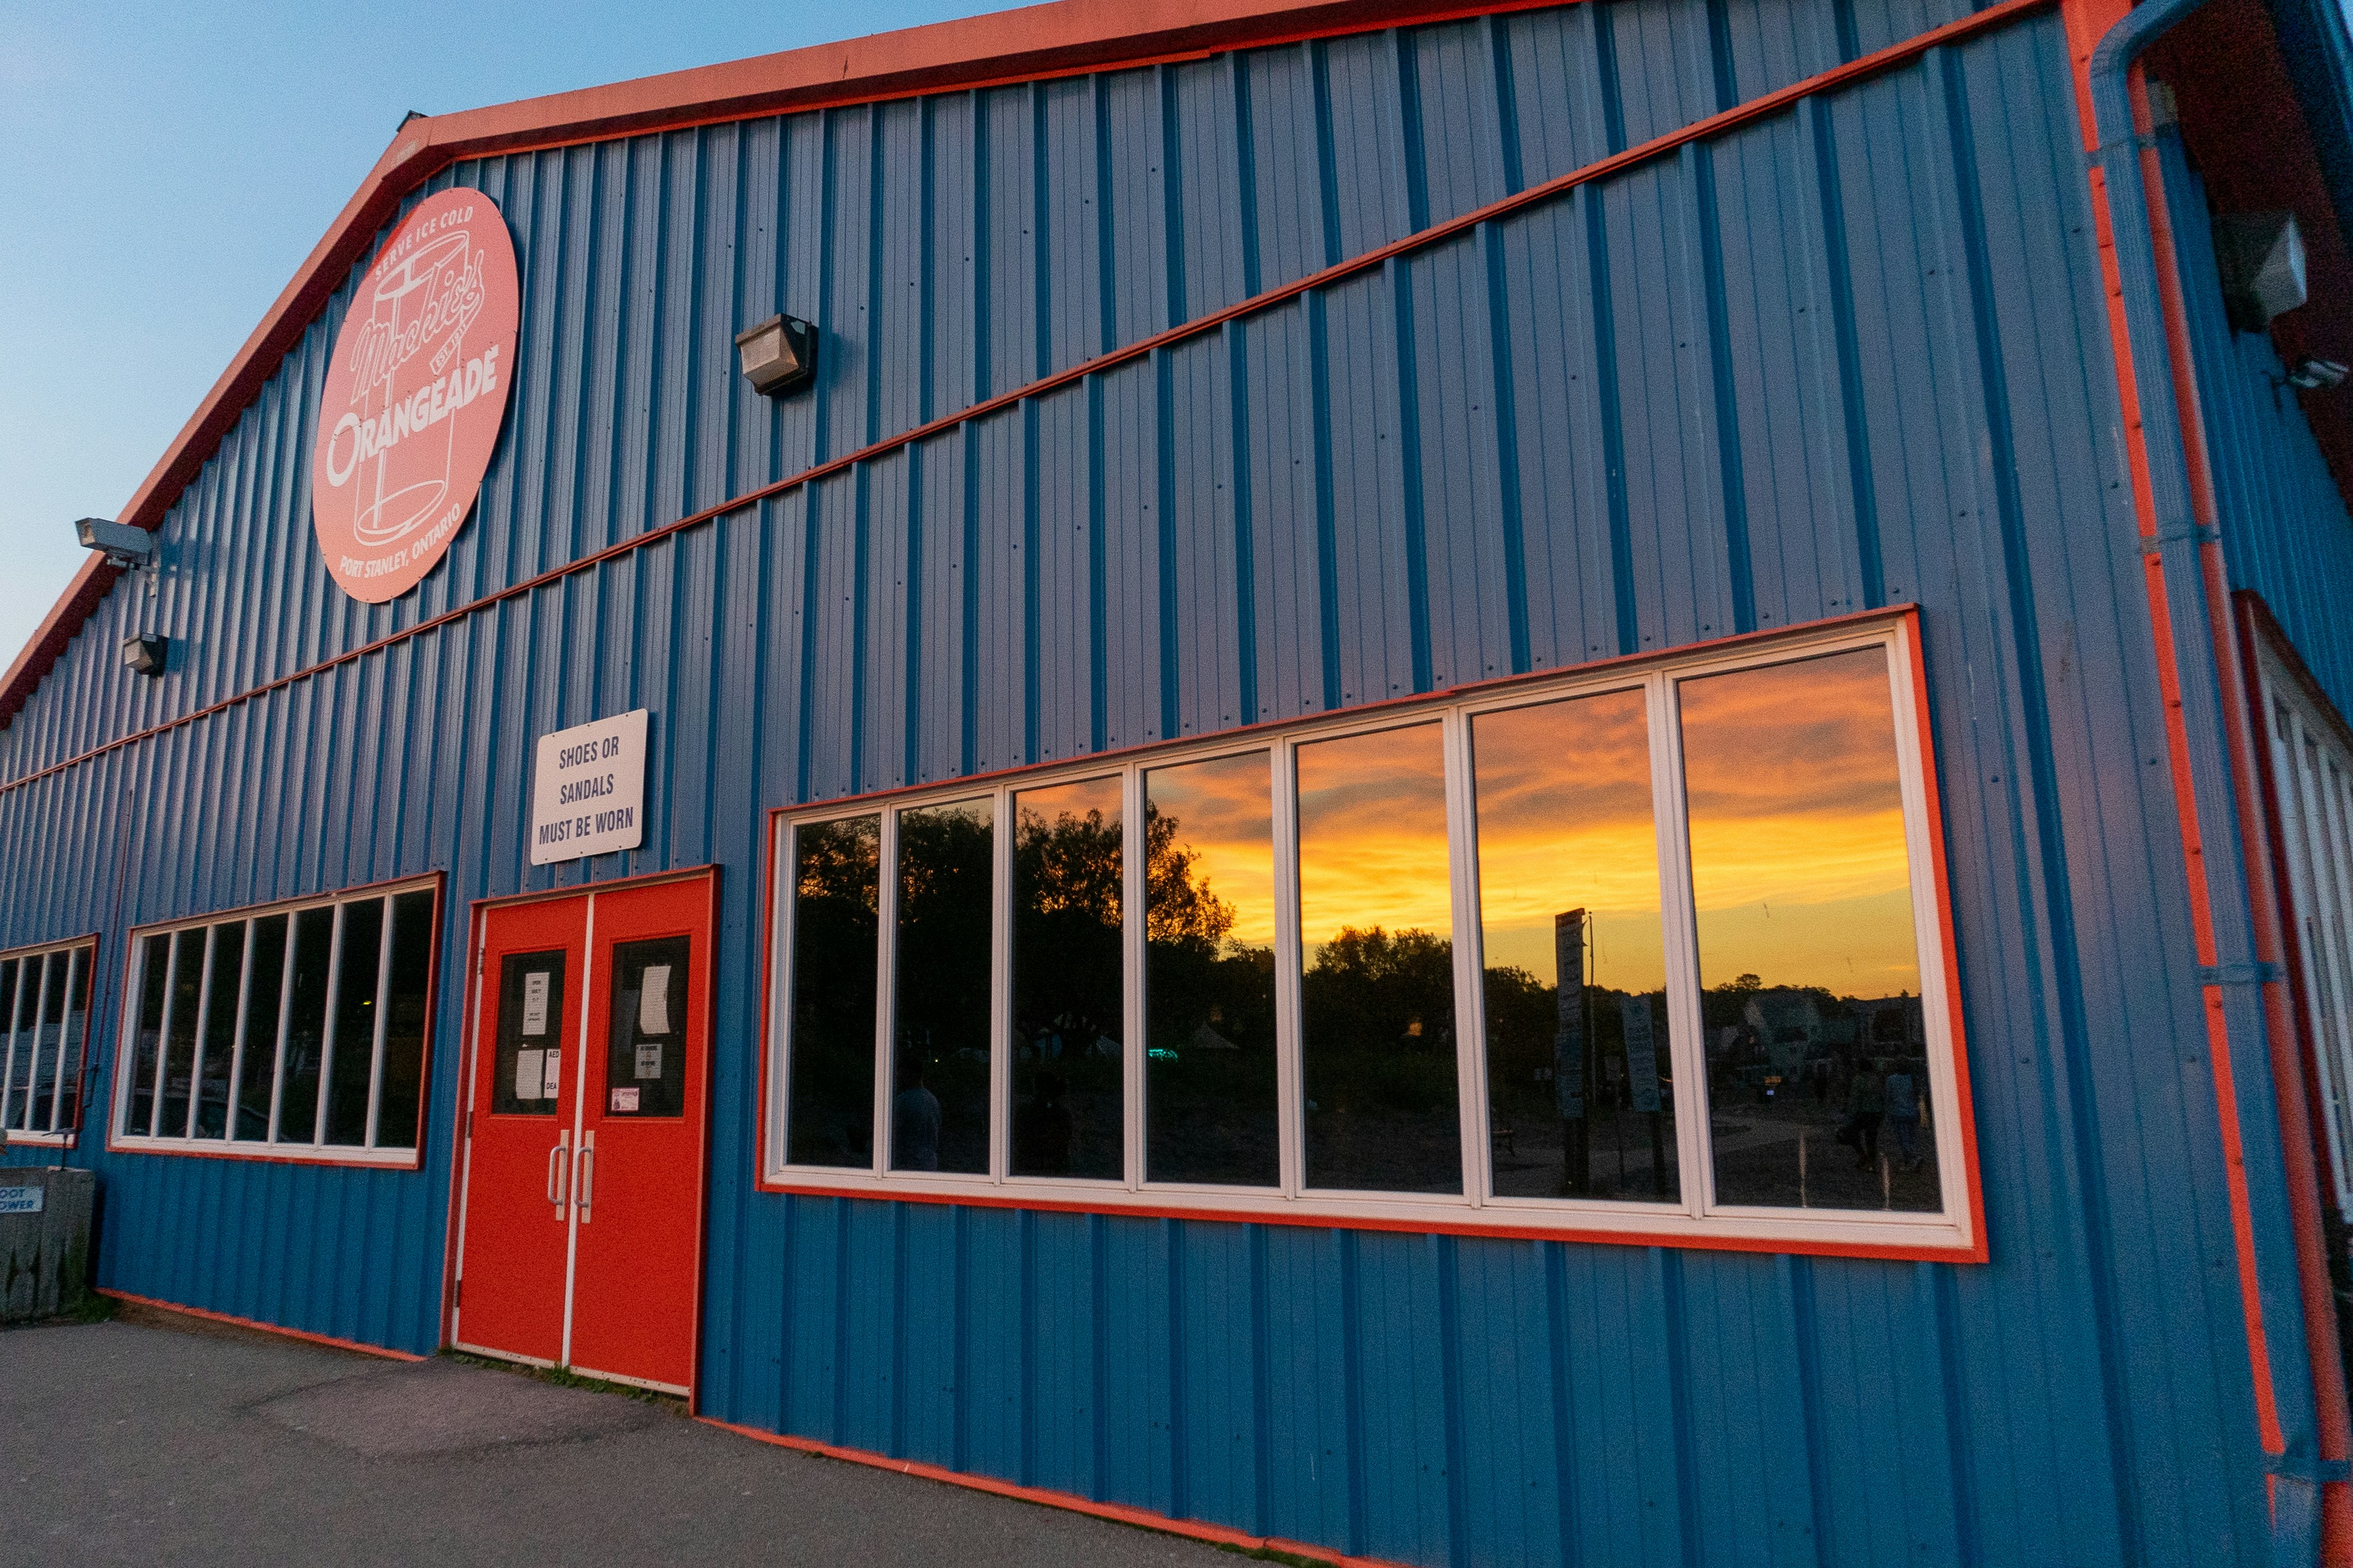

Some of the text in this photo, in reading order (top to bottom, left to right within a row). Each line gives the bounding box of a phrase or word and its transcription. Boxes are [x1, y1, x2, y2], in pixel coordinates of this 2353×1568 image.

[375, 206, 473, 281] SERVE ICE COLD
[327, 344, 499, 487] ORANGEADE
[339, 503, 461, 578] PORT STANLEY, ONTARIO
[559, 736, 619, 769] SHOES OR
[560, 773, 614, 805] SANDALS
[539, 807, 633, 845] MUST BE WORN
